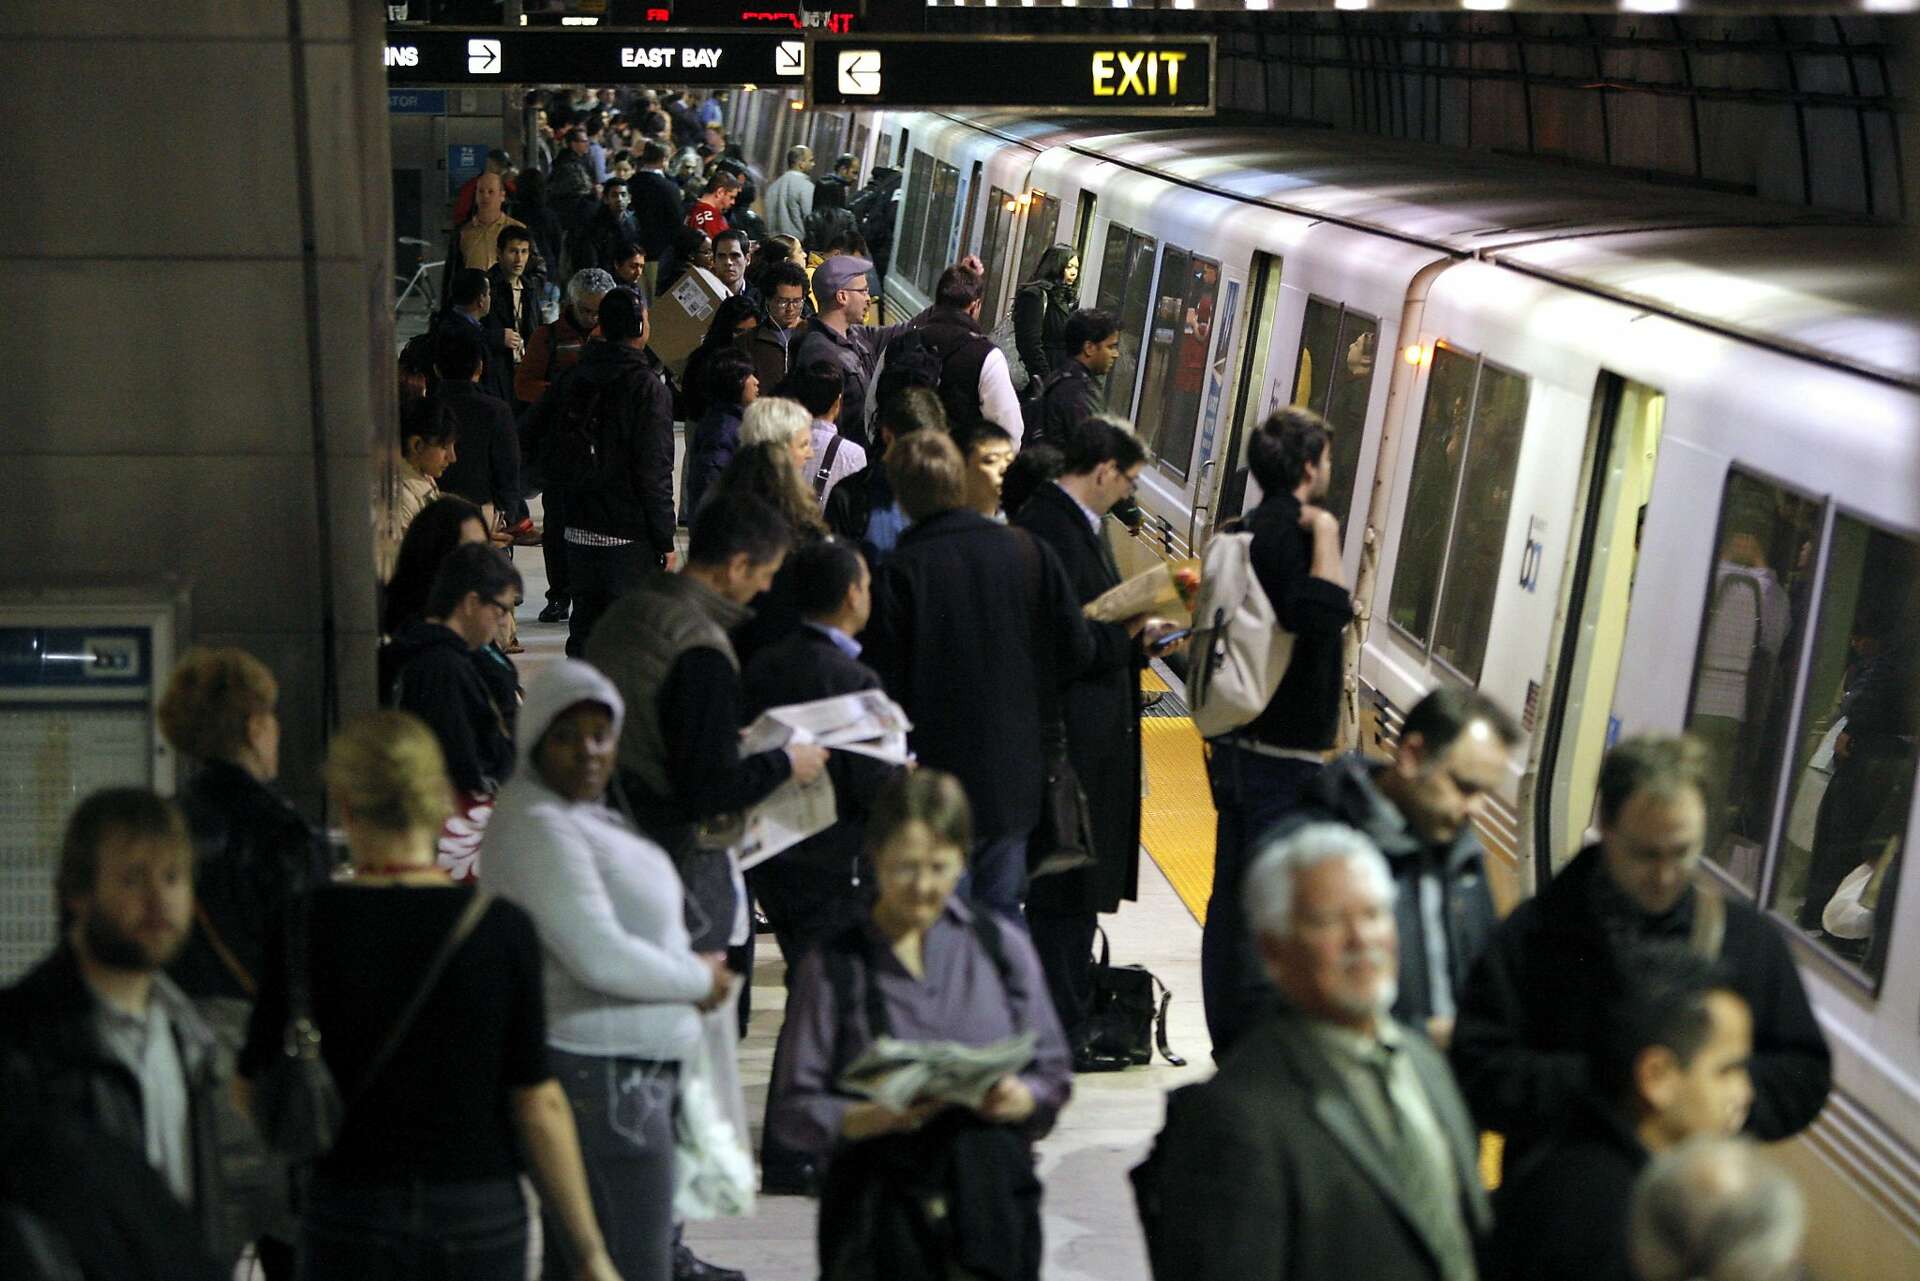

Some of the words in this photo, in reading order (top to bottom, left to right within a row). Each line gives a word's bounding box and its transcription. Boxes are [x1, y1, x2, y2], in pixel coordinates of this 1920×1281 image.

[621, 48, 676, 68] EAST
[682, 48, 722, 68] BAY
[1092, 51, 1187, 96] EXIT
[695, 210, 714, 225] 52
